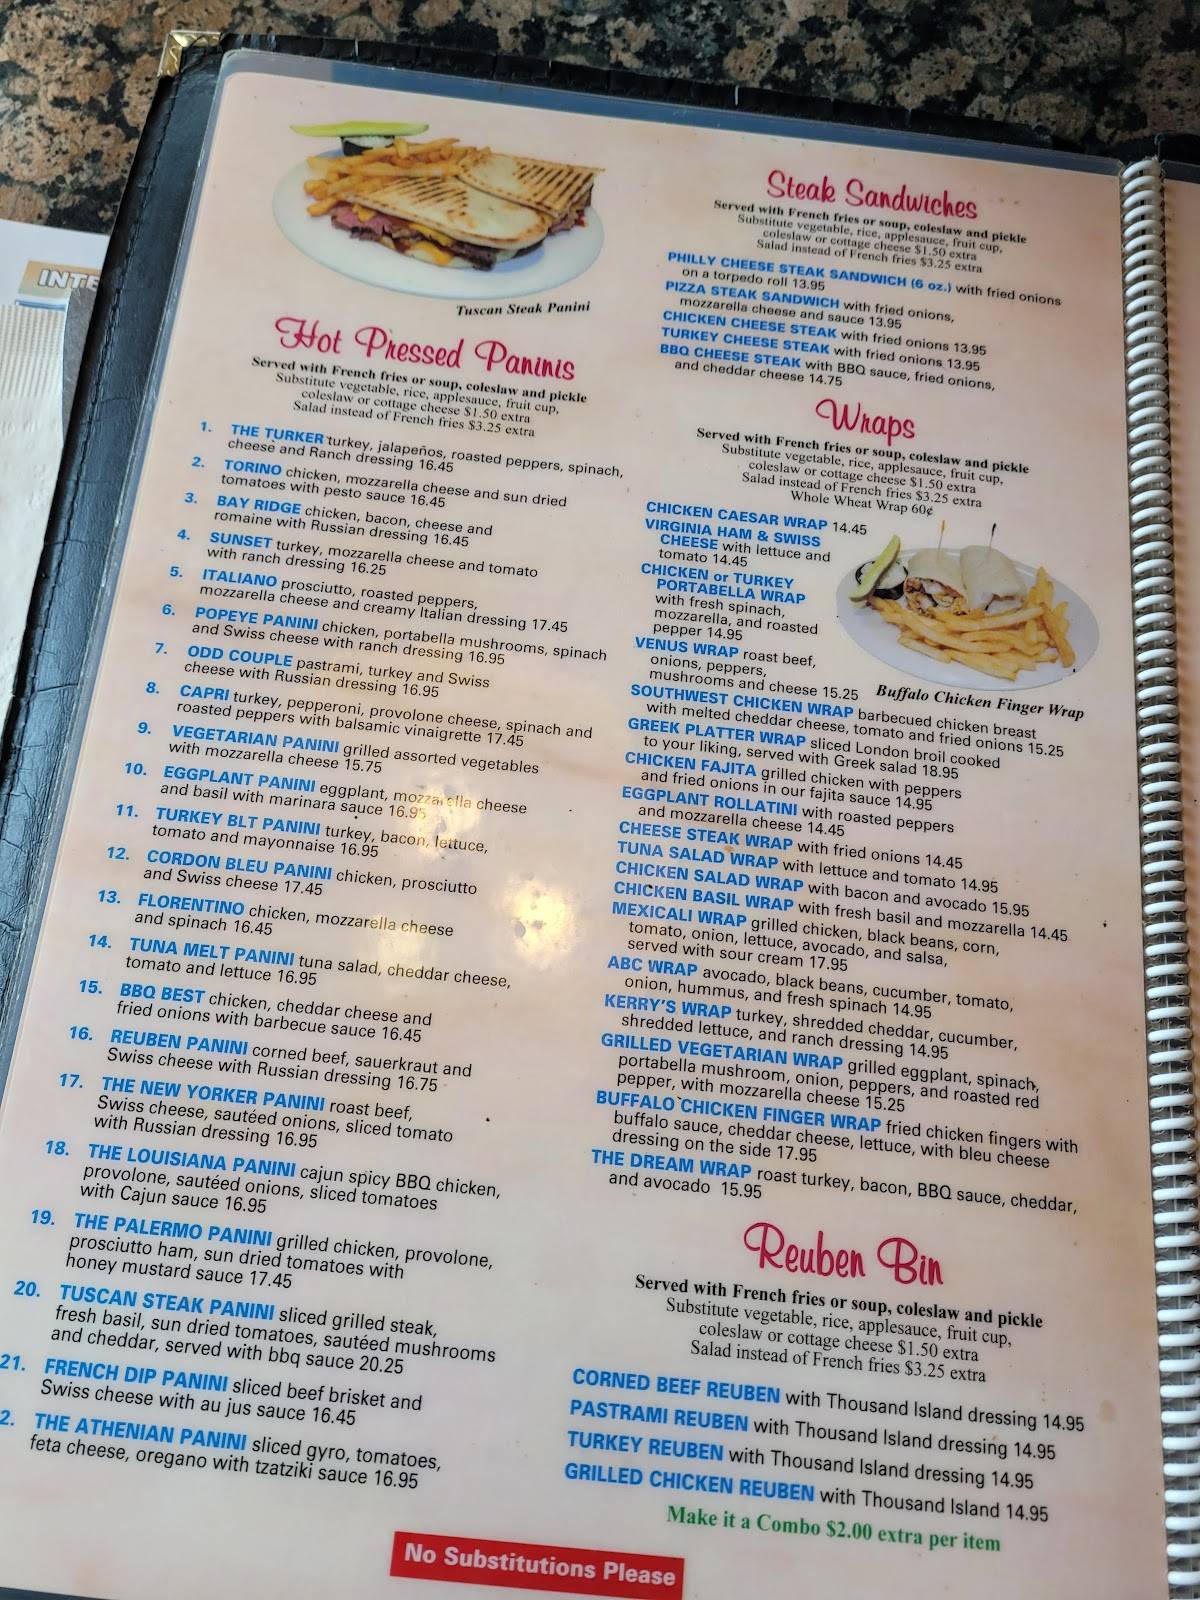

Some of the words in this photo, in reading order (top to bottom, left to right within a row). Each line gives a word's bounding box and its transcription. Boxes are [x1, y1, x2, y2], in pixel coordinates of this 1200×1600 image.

[766, 170, 836, 203] Steak
[844, 178, 978, 219] Sandwiches
[667, 251, 716, 266] PHILLY
[720, 256, 775, 273] CHEESE
[778, 263, 825, 278] STEAK
[829, 268, 907, 287] SANDWICH
[910, 278, 924, 289] (6
[927, 282, 952, 293] oz.)
[955, 284, 983, 296] with
[986, 286, 1015, 300] fried
[1018, 293, 1061, 306] onions
[681, 268, 698, 278] on
[701, 270, 710, 279] a
[713, 270, 763, 285] torpedo
[766, 276, 788, 288] roll
[792, 277, 825, 292] 13.95
[457, 305, 503, 316] Tuscan
[506, 302, 542, 314] Steak
[547, 300, 591, 313] Panini
[274, 316, 342, 354] Hot
[354, 326, 465, 369] Pressed
[473, 339, 575, 381] Paninis
[251, 357, 296, 371] Served
[299, 362, 327, 374] with
[331, 364, 376, 380] French
[380, 370, 408, 383] fries
[411, 377, 426, 385] or
[429, 379, 462, 392] soup,
[465, 381, 518, 396] coleslaw
[521, 388, 546, 399] and
[549, 390, 587, 403] pickle
[292, 400, 327, 414] Salad
[330, 404, 373, 419] instead
[375, 409, 392, 421] of
[392, 410, 434, 426] French
[438, 416, 465, 430] fries
[467, 419, 502, 433] $3.25
[504, 426, 535, 437] extra
[815, 398, 915, 446] Wraps
[200, 421, 213, 433] 1.
[231, 423, 260, 438] THE
[264, 427, 325, 445] TURKER
[328, 435, 373, 452] turkey,
[377, 440, 446, 460] jalapeños,
[450, 451, 502, 465] roasted
[505, 457, 564, 473] peppers,
[567, 462, 623, 479] spinach,
[227, 438, 276, 453] cheese
[279, 445, 306, 456] and
[309, 445, 351, 461] Ranch
[355, 450, 414, 471] dressing
[419, 457, 454, 473] 16.45
[646, 501, 713, 519] CHICKEN
[717, 508, 779, 526] CAESAR
[783, 515, 828, 530] WRAP
[832, 521, 867, 536] 14.45
[790, 489, 830, 504] Whole
[833, 494, 872, 509] Wheat
[875, 498, 908, 515] Wrap
[911, 503, 933, 517] 60¢
[644, 517, 713, 536] VIRGINIA
[716, 525, 753, 541] HAM
[756, 530, 769, 542] &
[773, 531, 821, 548] SWISS
[660, 533, 719, 550] CHEESE
[721, 541, 751, 554] with
[755, 543, 801, 560] lettuce
[804, 551, 831, 562] and
[658, 548, 708, 563] tomato
[712, 553, 748, 568] 14.45
[169, 565, 184, 578] 5.
[202, 568, 278, 587] ITALIANO
[280, 579, 356, 598] prosciutto,
[360, 588, 414, 602] roasted
[417, 594, 478, 611] peppers,
[199, 585, 276, 602] mozzarella
[279, 591, 329, 608] cheese
[332, 599, 360, 611] and
[362, 603, 416, 620] creamy
[419, 605, 462, 622] Italian
[466, 611, 527, 631] dressing
[532, 618, 568, 633] 17.45
[875, 684, 929, 701] Buffalo
[933, 690, 992, 709] Chicken
[996, 697, 1044, 716] Finger
[1049, 703, 1085, 722] Wrap
[107, 846, 131, 861] 12.
[146, 849, 221, 869] CORDON
[224, 857, 269, 874] BLEU
[273, 861, 333, 881] PANINI
[335, 868, 396, 889] chicken,
[401, 878, 477, 895] prosciutto
[88, 933, 113, 949] 14.
[130, 936, 178, 955] TUNA
[182, 942, 229, 960] MELT
[233, 947, 295, 967] PANINI
[298, 955, 333, 970] tuna
[337, 958, 382, 977] salad,
[387, 963, 450, 982] cheddar
[453, 969, 511, 990] cheese,
[125, 955, 181, 973] tomato
[185, 961, 216, 976] and
[219, 962, 272, 982] lettuce
[277, 969, 318, 986] 16.95
[607, 955, 643, 972] ABC
[647, 959, 698, 977] WRAP
[702, 967, 770, 987] avocado,
[775, 972, 815, 990] black
[818, 976, 868, 998] beans,
[872, 985, 952, 1006] cucumber,
[955, 993, 1013, 1013] tomato,
[593, 1148, 625, 1167] THE
[629, 1152, 694, 1174] DREAM
[699, 1159, 752, 1179] WRAP
[757, 1169, 797, 1185] roast
[800, 1171, 855, 1193] turkey,
[859, 1175, 912, 1198] bacon,
[917, 1181, 952, 1200] BBQ
[956, 1189, 1006, 1208] sauce,
[1010, 1192, 1077, 1215] cheddar,
[608, 1171, 639, 1187] and
[643, 1176, 711, 1194] avocado
[721, 1180, 762, 1199] 15.95
[743, 1223, 866, 1279] Reuben
[876, 1236, 944, 1286] Bin
[572, 1367, 651, 1391] CORNED
[656, 1375, 701, 1396] BEEF
[706, 1380, 781, 1404] REUBEN
[785, 1389, 821, 1408] with
[826, 1392, 909, 1416] Thousand
[914, 1400, 963, 1421] Island
[967, 1406, 1037, 1432] dressing
[1043, 1413, 1085, 1432] 14.95
[35, 1412, 71, 1432] THE
[73, 1417, 175, 1444] ATHENIAN
[179, 1427, 247, 1451] PANINI
[251, 1435, 302, 1456] sliced
[306, 1444, 350, 1464] gyro,
[356, 1447, 441, 1472] tomatoes,
[667, 1505, 718, 1527] Make
[723, 1510, 736, 1528] it
[740, 1516, 750, 1530] a
[756, 1513, 821, 1536] Combo
[826, 1519, 873, 1540] $2.00
[877, 1528, 923, 1545] extra
[929, 1533, 958, 1551] per
[963, 1532, 1001, 1552] item
[404, 1542, 437, 1564] No
[443, 1546, 596, 1579] Substitutions
[603, 1560, 676, 1586] Please
